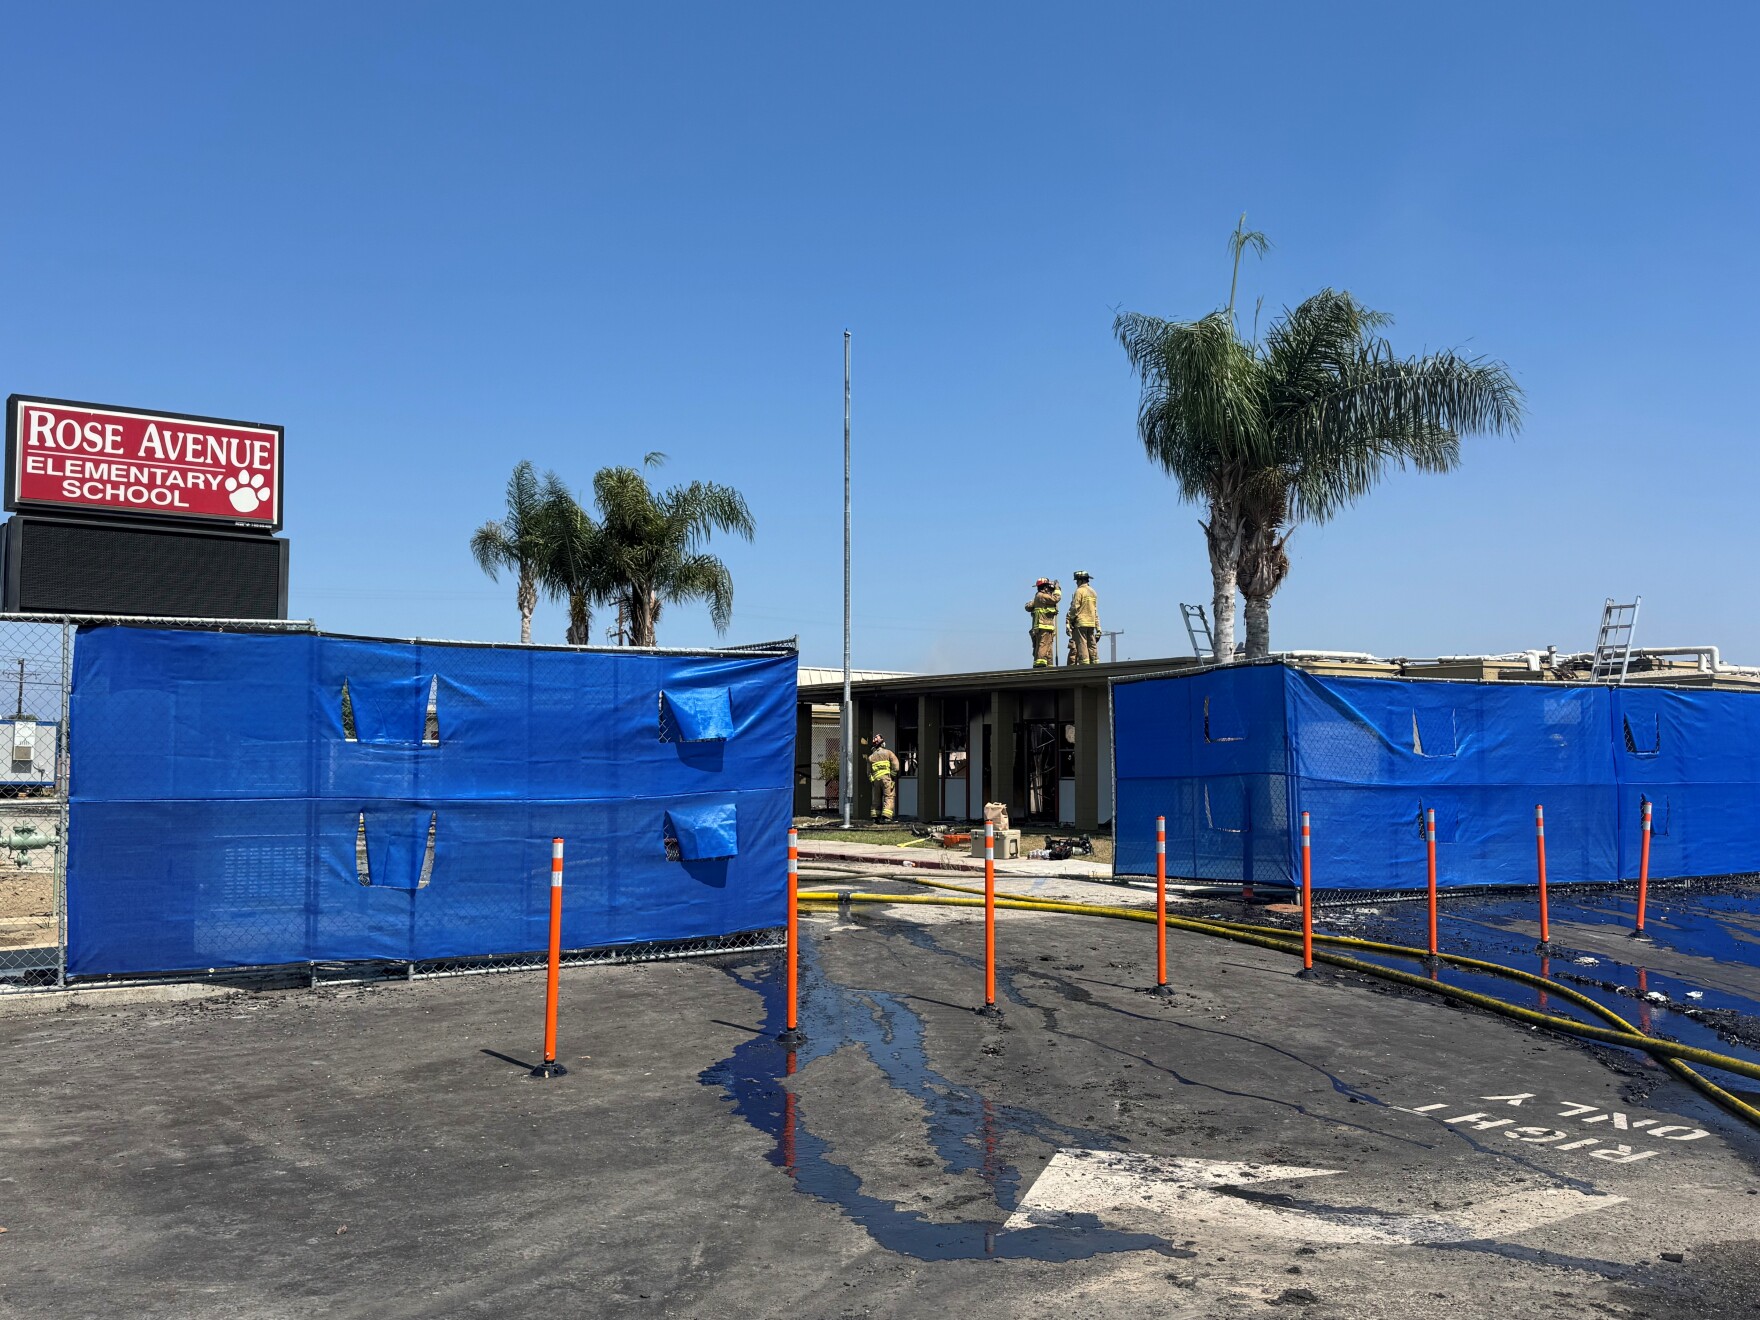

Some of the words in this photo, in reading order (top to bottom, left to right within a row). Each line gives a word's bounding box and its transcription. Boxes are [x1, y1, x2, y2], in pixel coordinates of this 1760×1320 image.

[28, 410, 124, 454] ROSE
[137, 423, 271, 470] AVENUE
[26, 455, 224, 491] ELEMENTARY
[62, 480, 189, 507] SCHOOL
[1388, 1103, 1660, 1163] RIGHT
[1480, 1093, 1710, 1141] ONLY
